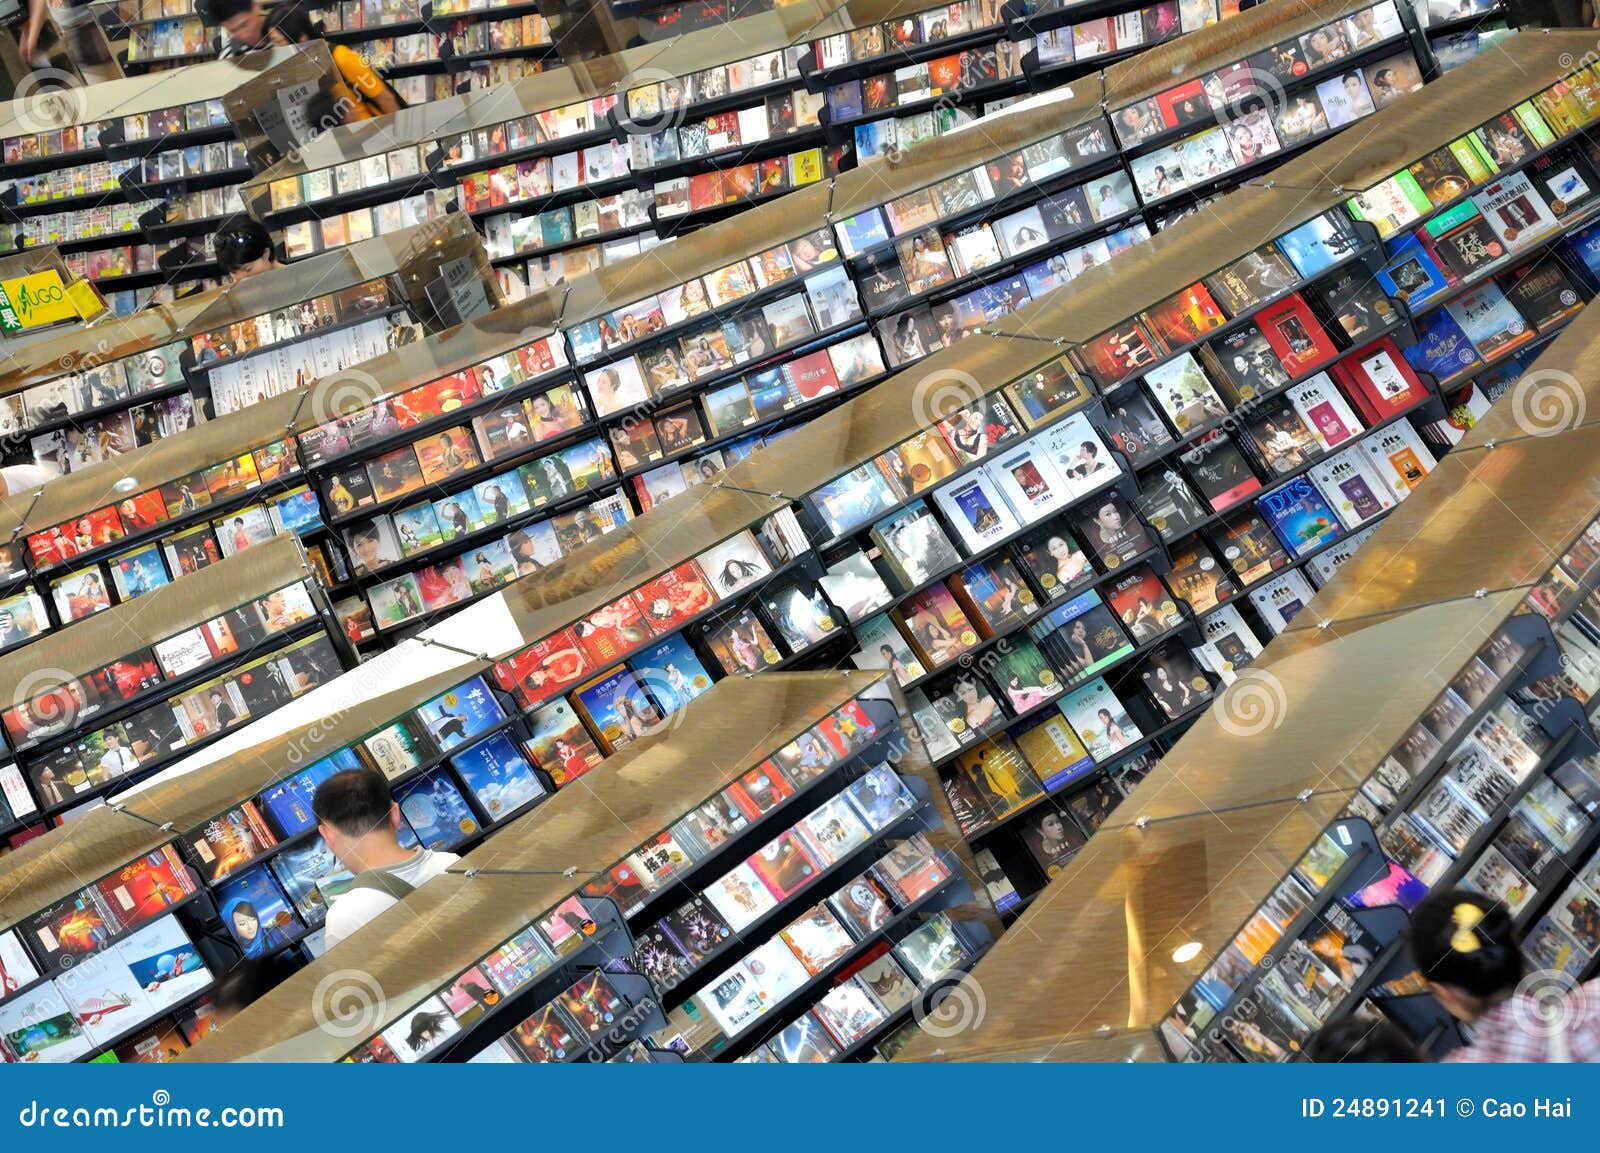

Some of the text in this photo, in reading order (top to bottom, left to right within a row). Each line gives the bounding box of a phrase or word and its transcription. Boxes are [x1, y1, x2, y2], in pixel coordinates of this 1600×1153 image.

[1299, 388, 1319, 402] dts
[1381, 432, 1401, 448] dts
[1331, 460, 1352, 476] dts
[1267, 479, 1314, 511] DTS
[1331, 551, 1351, 566] dts
[1271, 584, 1290, 600] dts
[1206, 618, 1226, 634] dts
